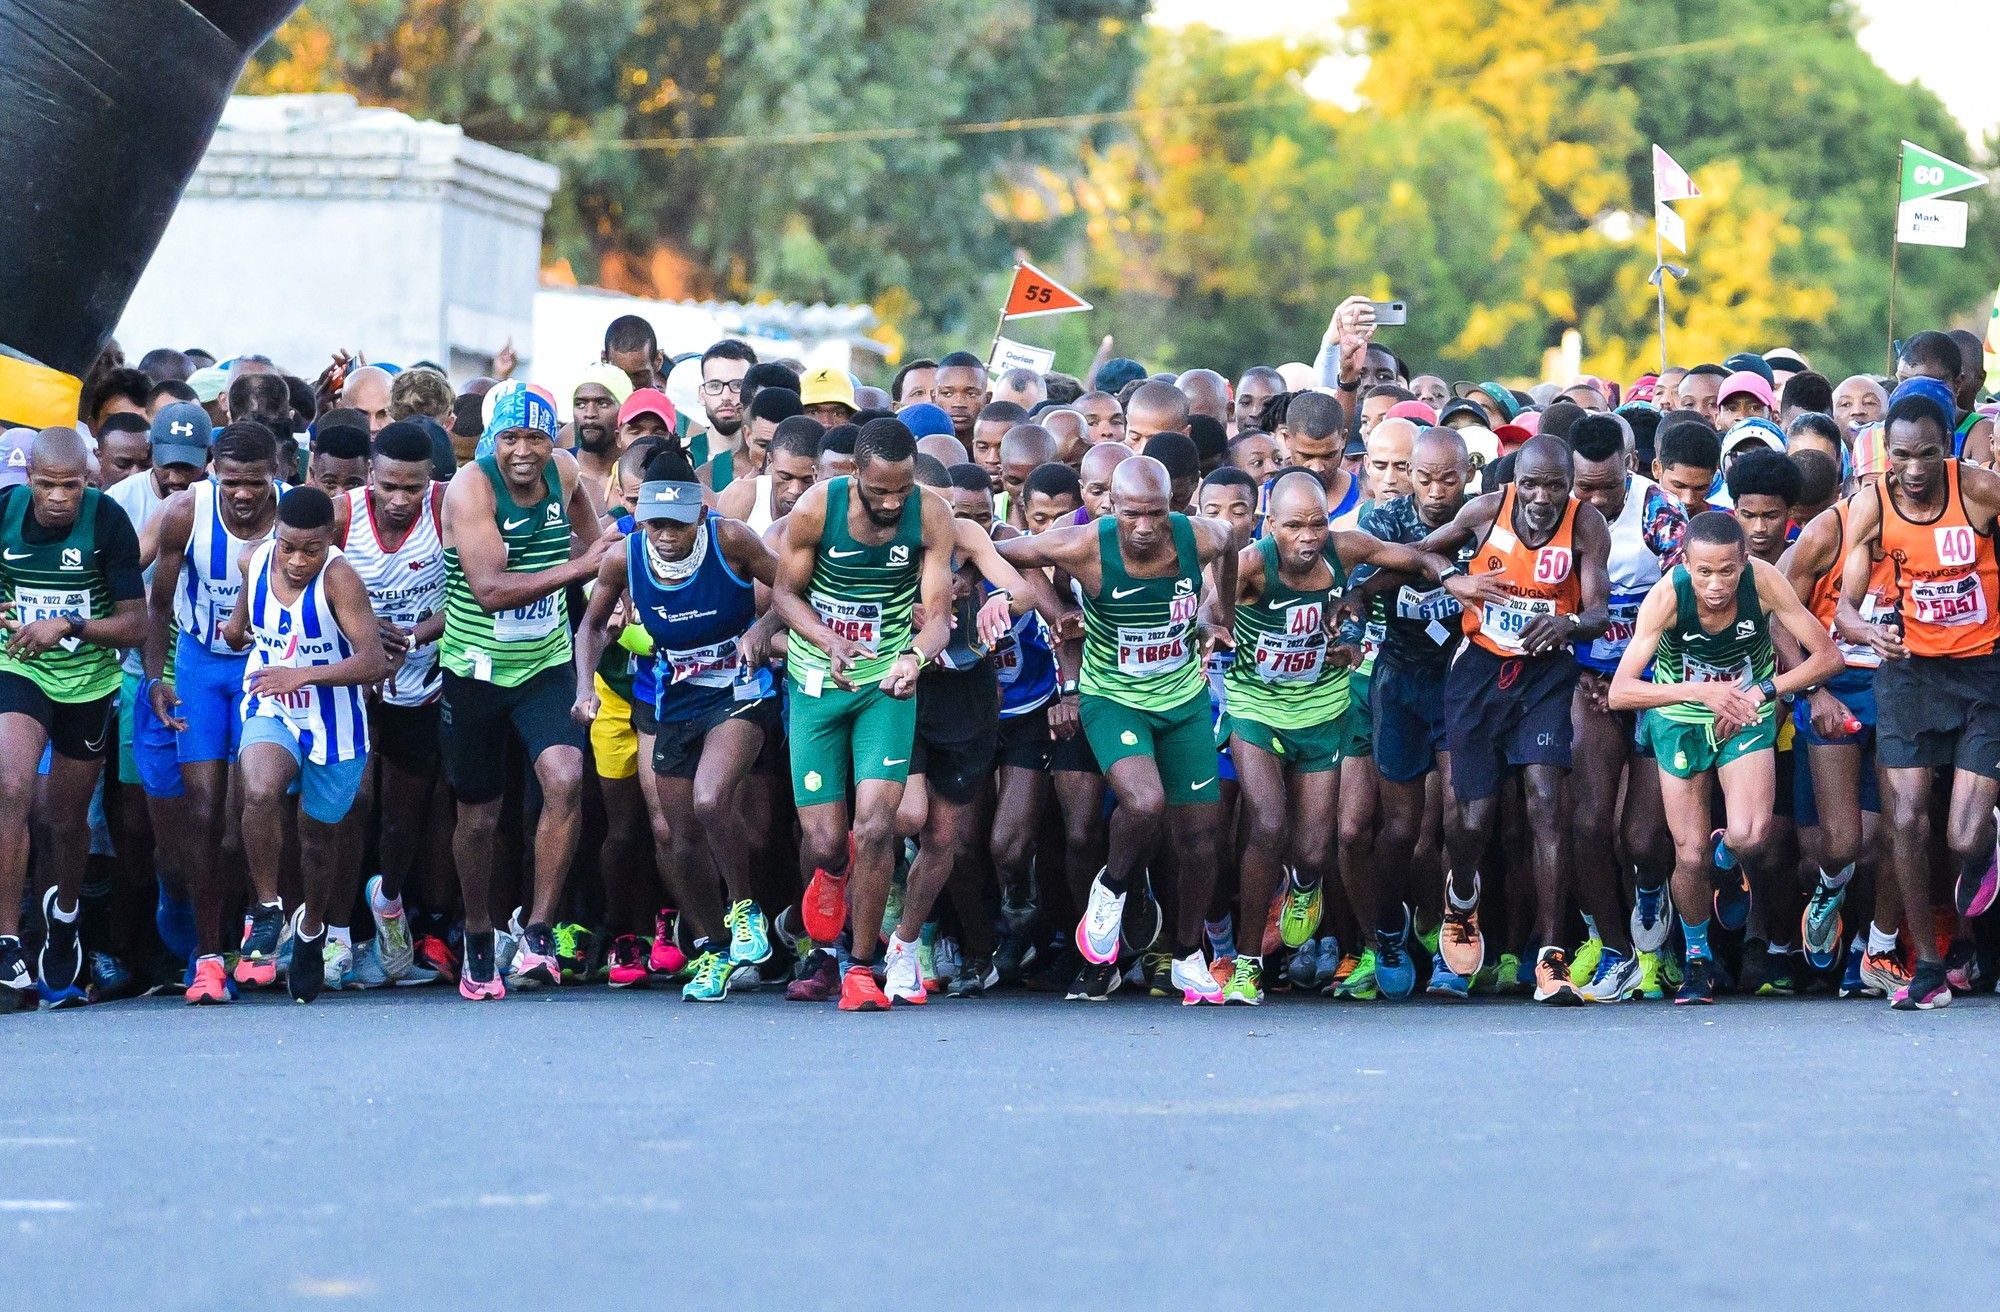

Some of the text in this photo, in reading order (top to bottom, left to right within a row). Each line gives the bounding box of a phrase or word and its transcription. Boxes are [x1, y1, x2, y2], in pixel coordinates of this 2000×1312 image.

[1914, 165, 1944, 186] 60
[1914, 213, 1940, 222] Mark
[1025, 285, 1052, 304] 55
[1006, 351, 1034, 365] Dorian
[1942, 529, 1971, 562] 40
[1538, 549, 1569, 580] 50
[20, 595, 38, 604] WPA
[43, 595, 61, 604] 2022
[1404, 591, 1421, 604] WPA
[1916, 588, 1934, 597] WPA
[1937, 585, 1955, 594] 2022
[815, 601, 833, 612] WPA
[837, 605, 855, 615] 2022
[1171, 596, 1196, 623] 40
[1400, 597, 1460, 620] T 6115
[1485, 601, 1494, 625] T
[1510, 599, 1528, 610] 2022
[1918, 591, 1978, 620] P 5957
[18, 605, 27, 624] T
[1291, 606, 1318, 636] 40
[1124, 634, 1143, 642] WPA
[1148, 632, 1166, 640] 2022
[1264, 639, 1282, 649] WPA
[1287, 638, 1304, 648] 2022
[299, 642, 333, 654] VOB
[1120, 646, 1131, 664] P
[1256, 649, 1318, 672] P 7156
[1685, 666, 1695, 682] P
